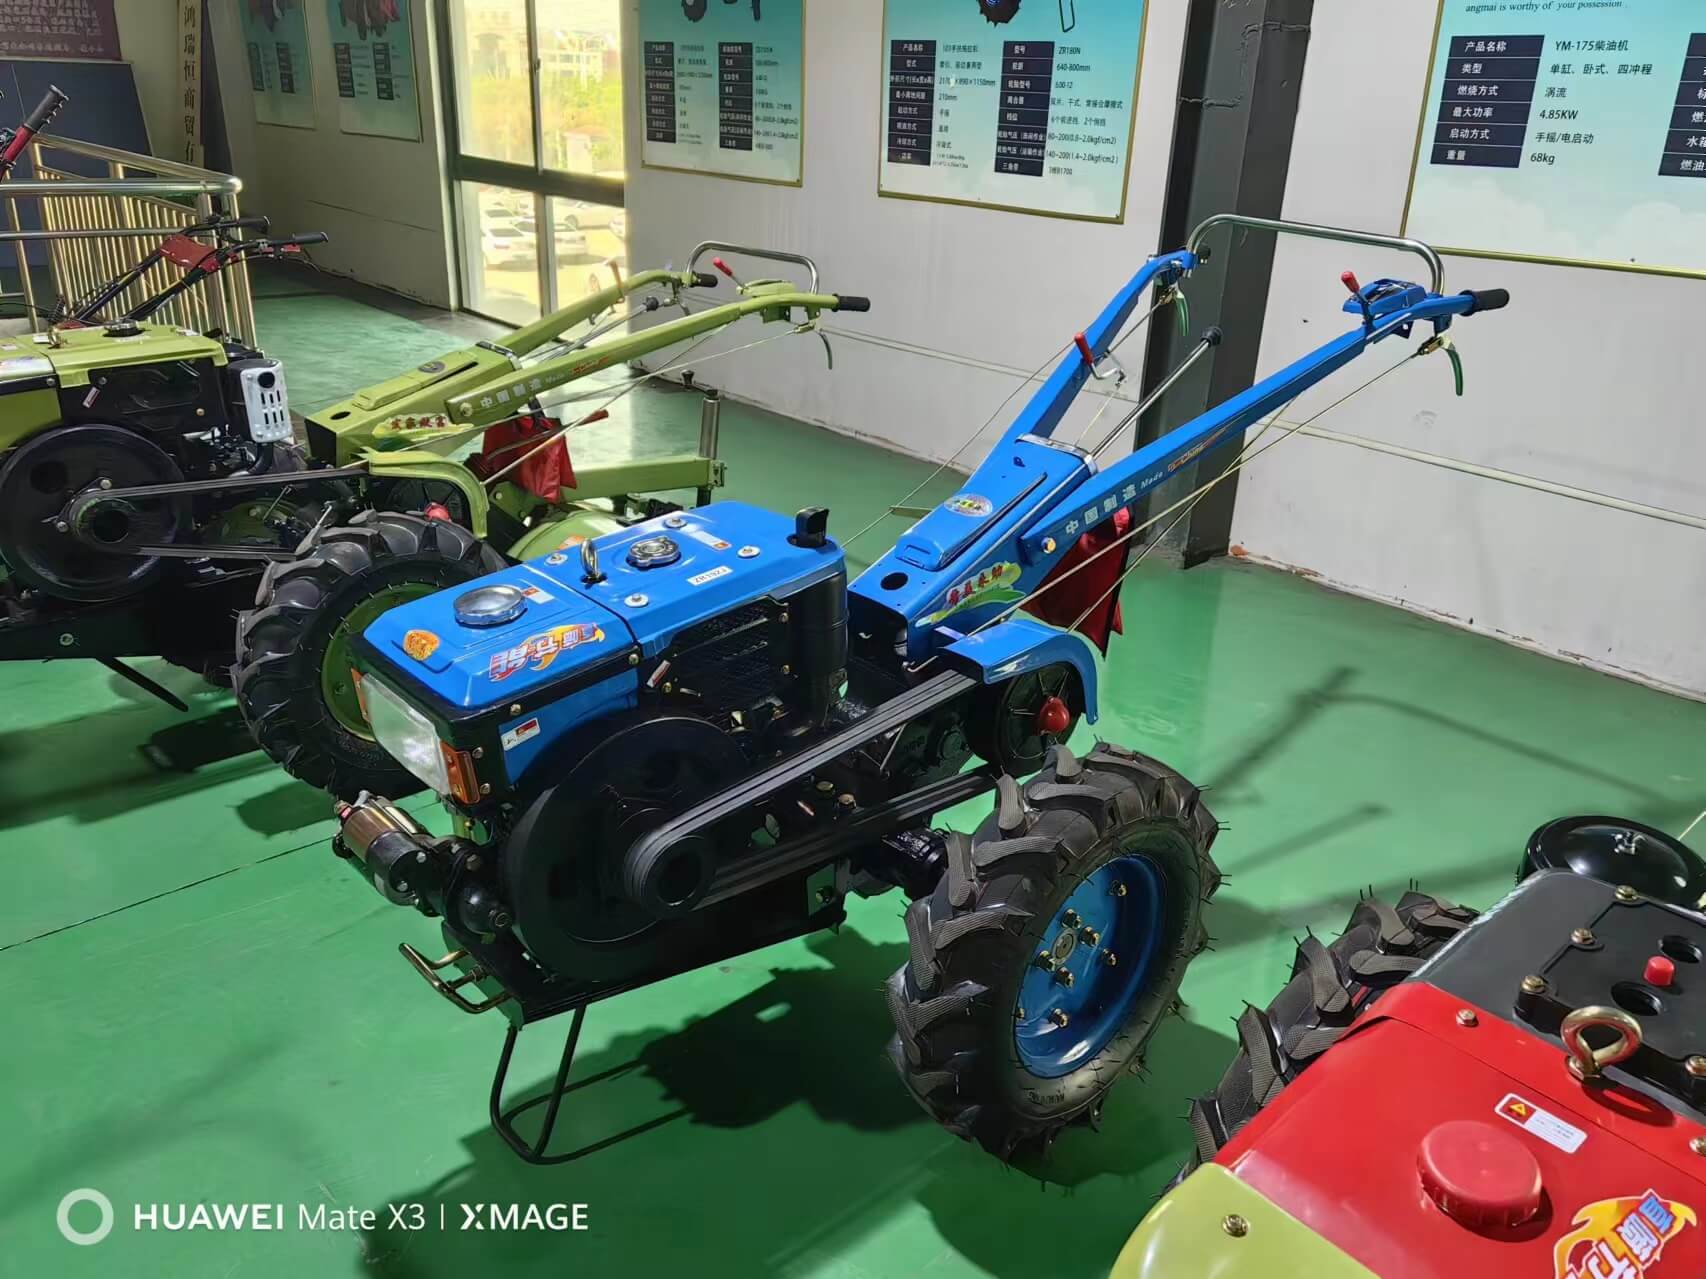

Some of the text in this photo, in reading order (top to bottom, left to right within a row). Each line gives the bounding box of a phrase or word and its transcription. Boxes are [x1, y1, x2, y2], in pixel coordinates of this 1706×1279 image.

[1499, 3, 1507, 12] is
[1509, 2, 1540, 13] worthy
[1541, 1, 1552, 11] of
[1556, 1, 1577, 12] your
[1577, 0, 1623, 11] possession
[1464, 41, 1507, 53] 产品名称
[1555, 39, 1629, 51] YM-175柴油机
[1461, 63, 1482, 74] 类型
[1457, 85, 1499, 97] 燃烧方式
[1544, 87, 1568, 98] 涡流
[1453, 106, 1494, 118] 最大功率
[1539, 109, 1579, 120] 4.85KW
[1691, 111, 1706, 123] 燃
[1449, 128, 1491, 140] 启动方式
[1535, 131, 1594, 145] 手摇/电启动
[1446, 149, 1467, 161] 重量
[1530, 152, 1556, 165] 68kg
[1680, 159, 1706, 171] 燃油
